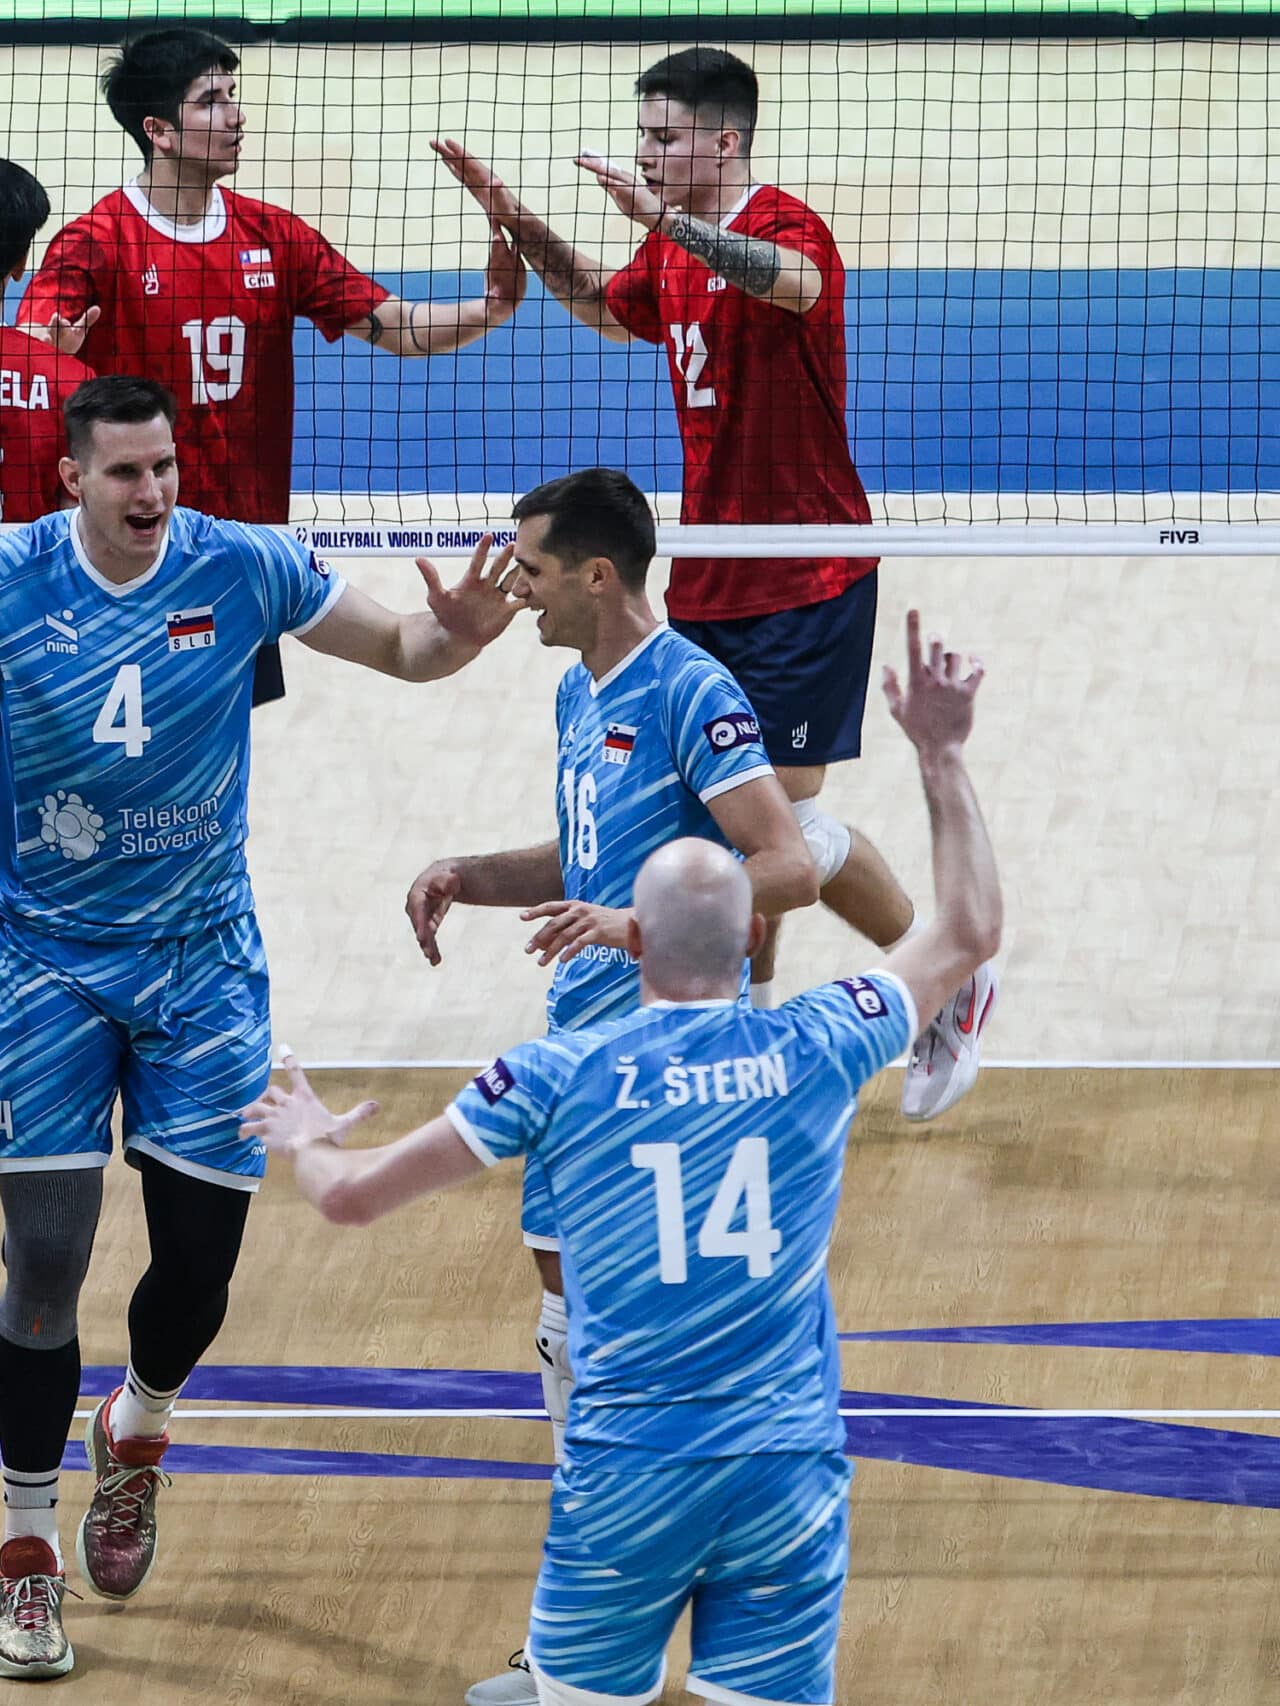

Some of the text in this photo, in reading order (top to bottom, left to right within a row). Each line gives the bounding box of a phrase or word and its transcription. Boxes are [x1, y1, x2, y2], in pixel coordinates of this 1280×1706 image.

[182, 316, 246, 404] 19
[670, 321, 717, 409] 12
[312, 531, 383, 548] VOLLEYBALL
[388, 531, 433, 548] WORLD
[1159, 530, 1199, 544] FIVB
[46, 639, 79, 655] nine
[173, 633, 212, 650] SLO
[92, 664, 152, 758] 4
[119, 795, 220, 831] Telekom
[121, 817, 223, 857] Slovenije
[563, 769, 598, 870] 16
[615, 1053, 789, 1109] Ž. ŠTERN
[630, 1136, 781, 1285] 14
